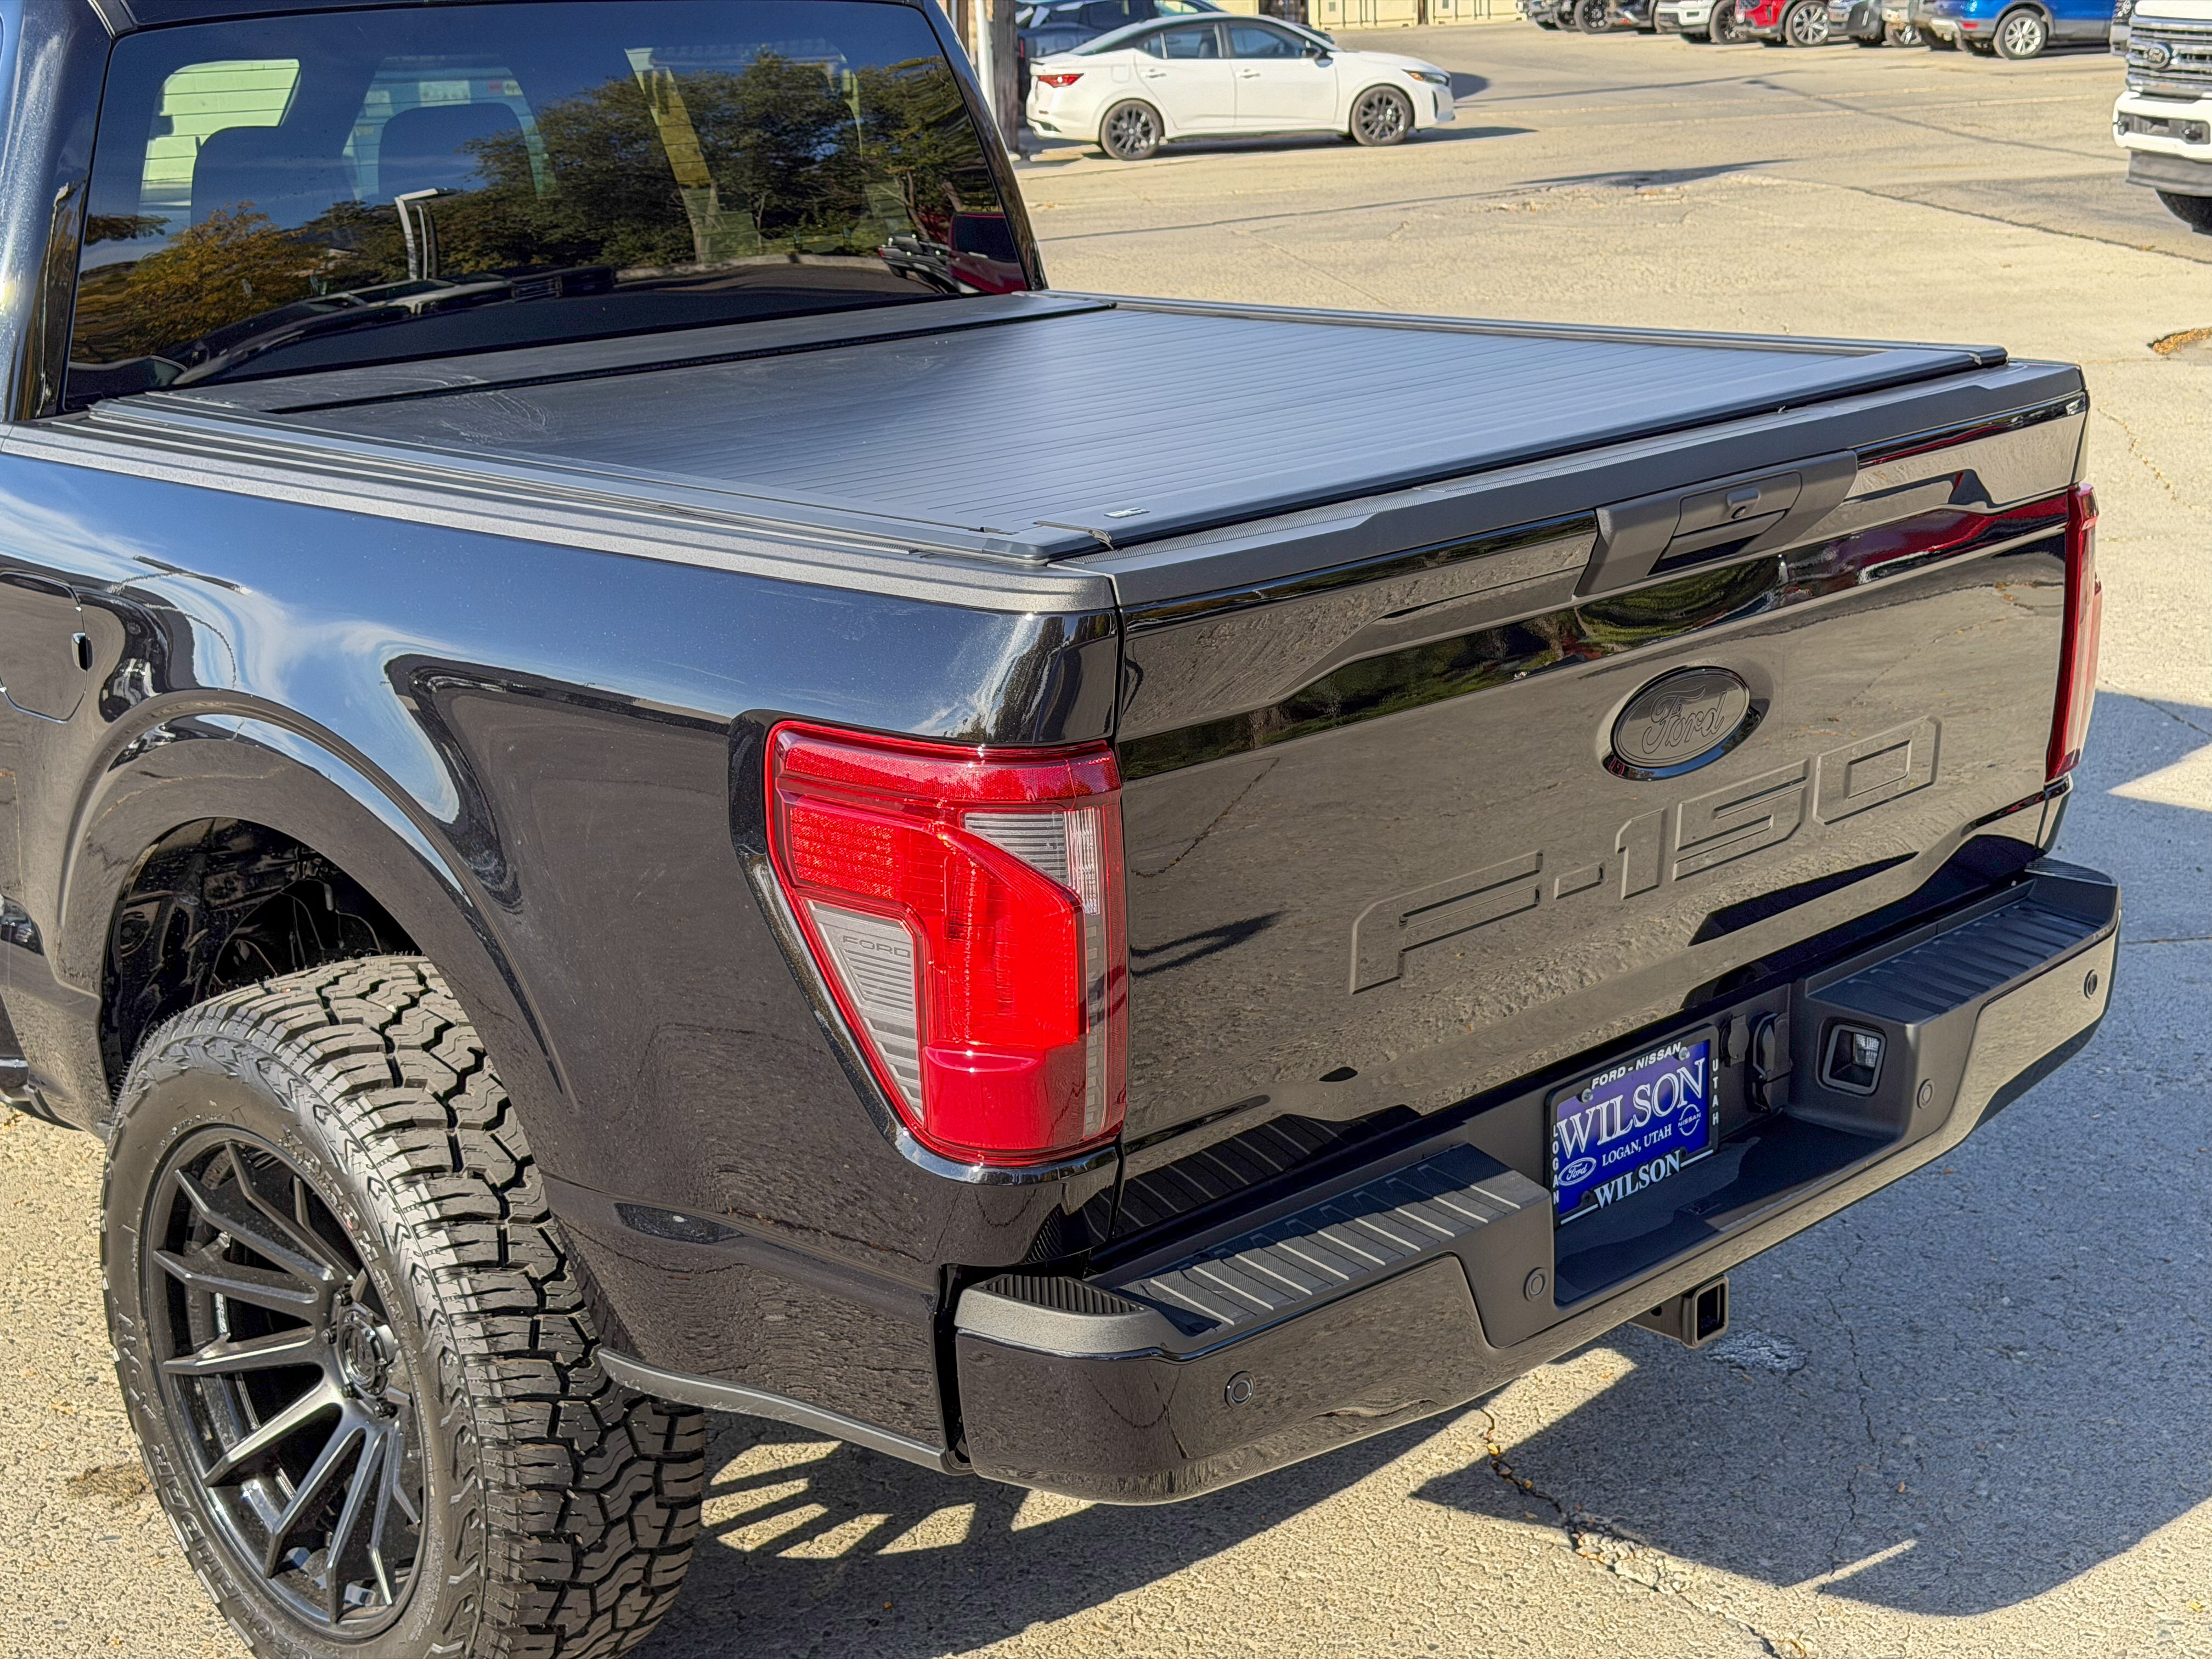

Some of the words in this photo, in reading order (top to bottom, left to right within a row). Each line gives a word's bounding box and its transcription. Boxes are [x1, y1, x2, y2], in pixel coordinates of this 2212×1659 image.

[1642, 684, 1728, 754] Ford
[1351, 715, 1941, 994] F-150
[843, 935, 911, 958] FORD
[1592, 1066, 1626, 1090] FORD
[1635, 1041, 1681, 1071] NISSAN
[1557, 1057, 1706, 1159] WILSON
[1678, 1111, 1701, 1127] NISSAN
[1602, 1139, 1641, 1167] LOGAN,
[1644, 1124, 1673, 1148] UTAH
[1566, 1162, 1588, 1181] Ford
[1594, 1150, 1681, 1209] WILSON
